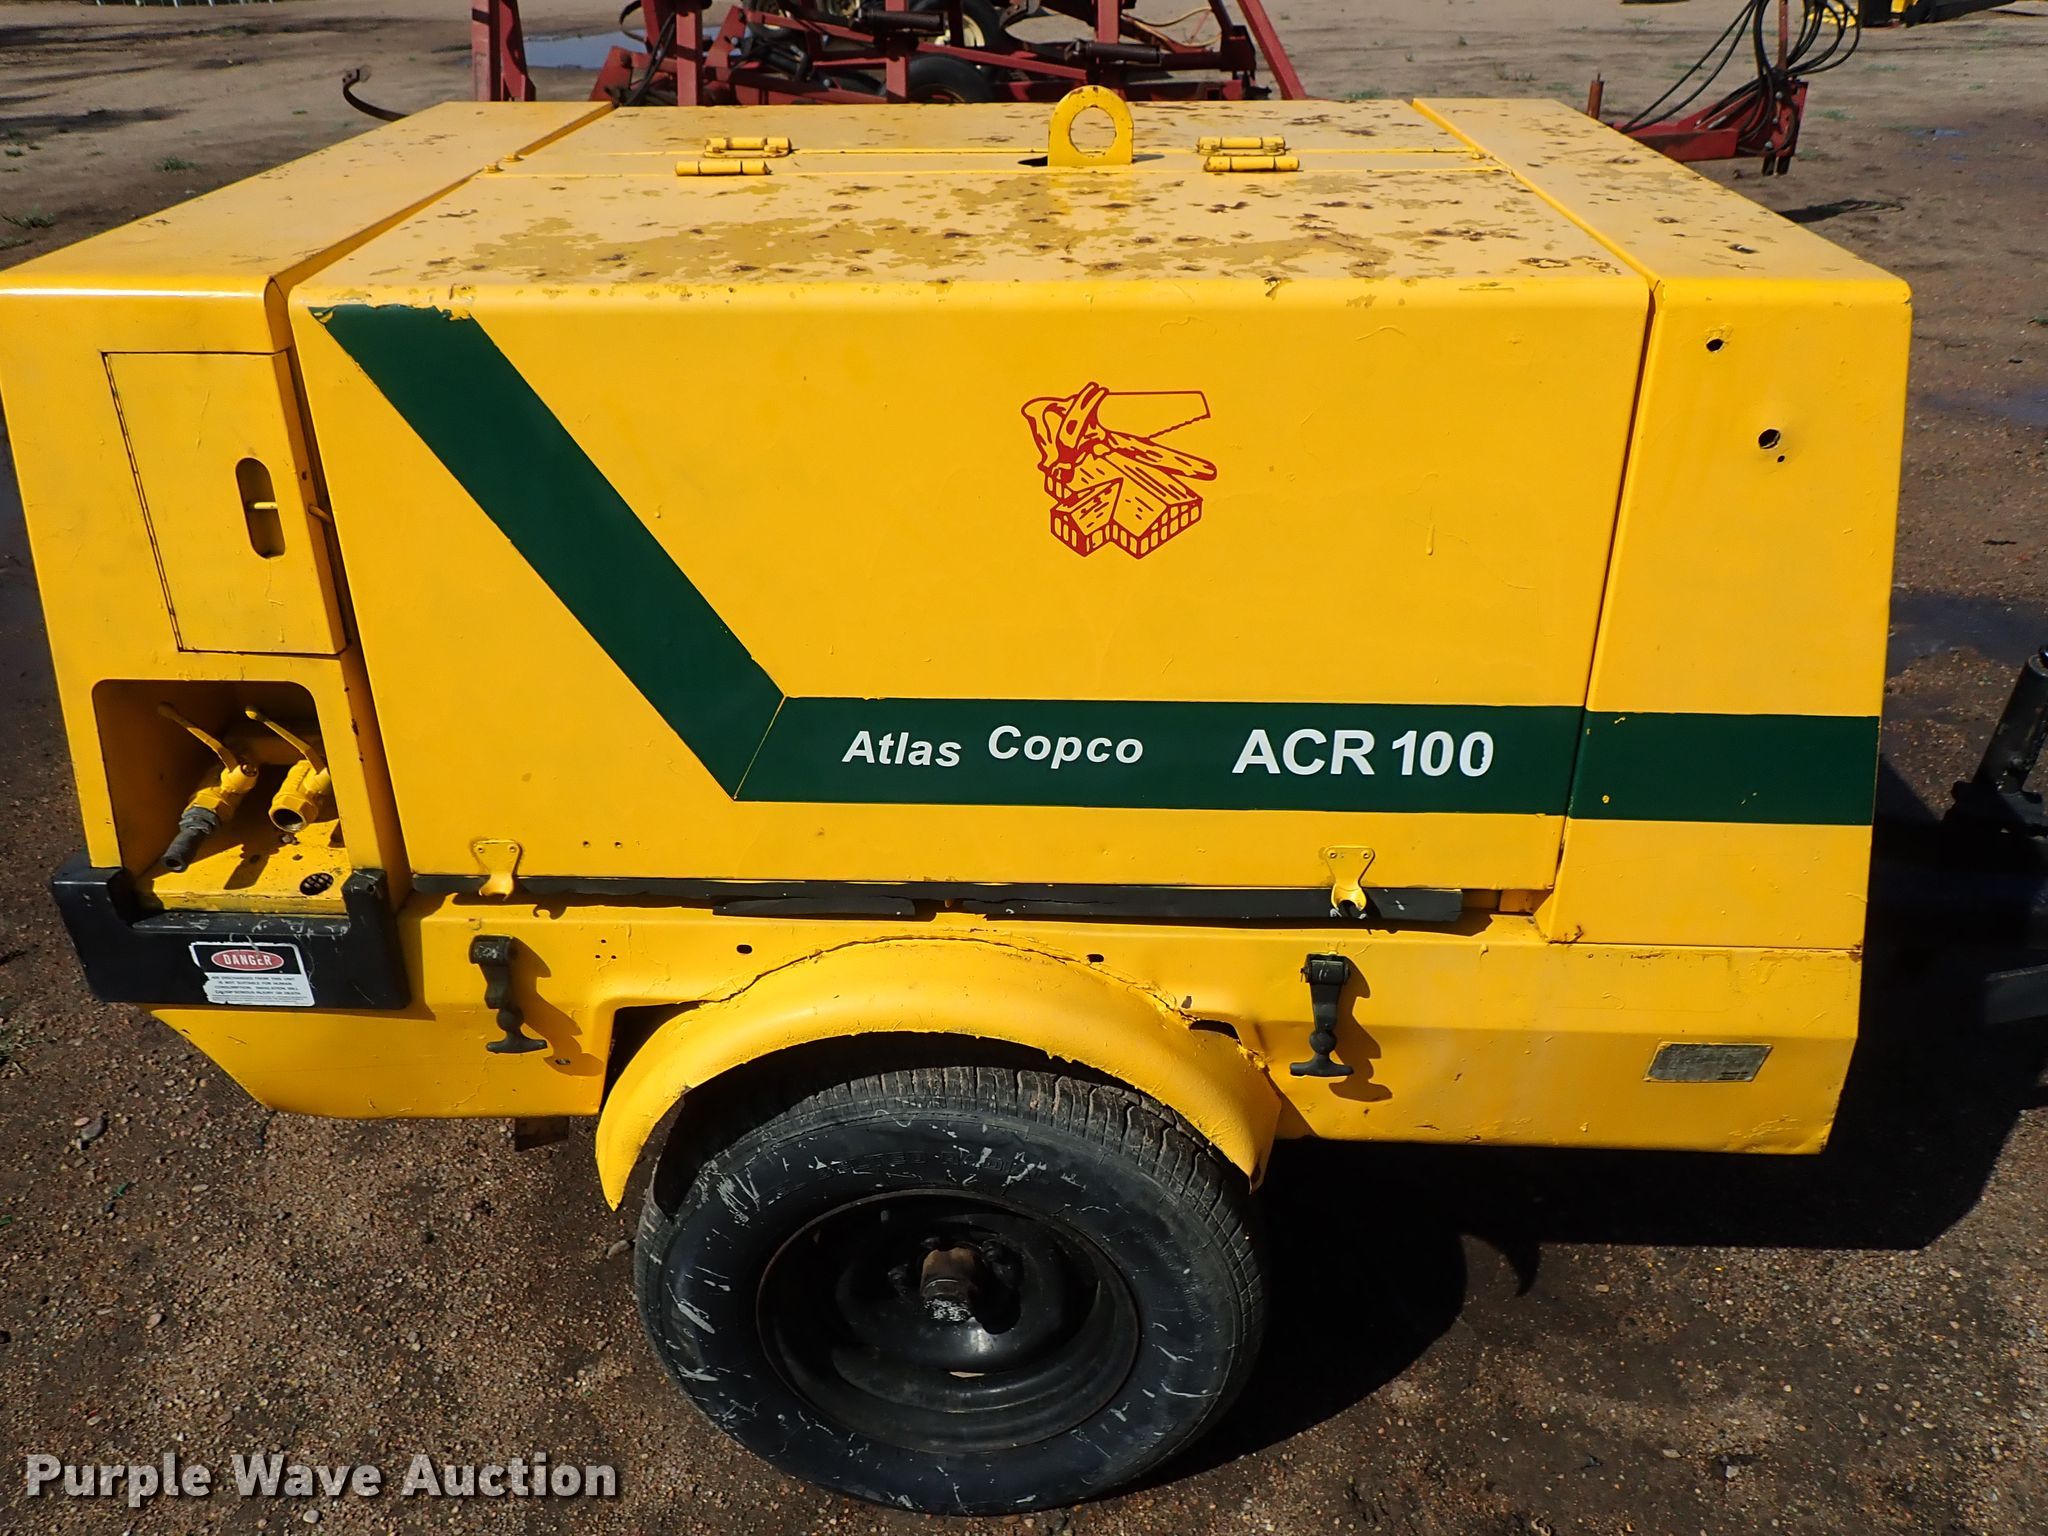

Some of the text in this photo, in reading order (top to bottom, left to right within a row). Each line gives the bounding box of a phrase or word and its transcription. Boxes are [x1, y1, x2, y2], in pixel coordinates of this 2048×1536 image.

[842, 726, 1143, 770] Atlas Copco
[1232, 729, 1494, 777] ACR 100
[222, 953, 273, 966] DANGER
